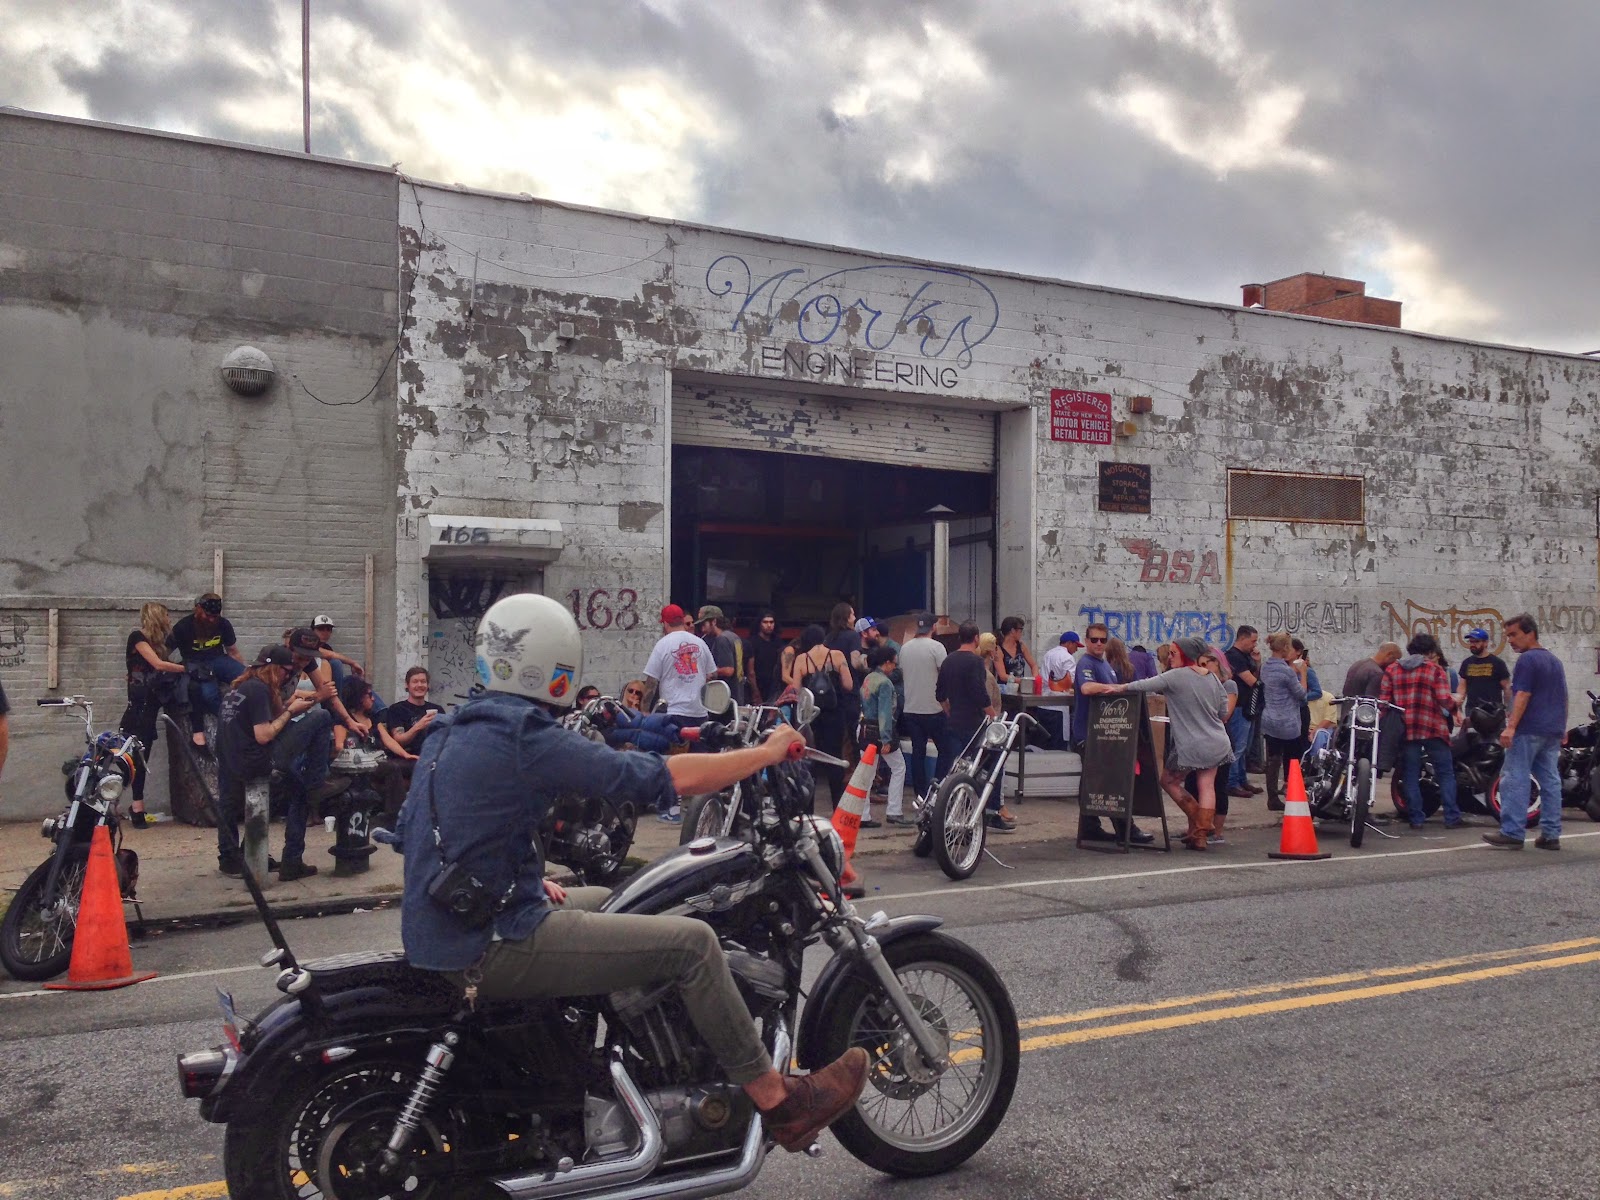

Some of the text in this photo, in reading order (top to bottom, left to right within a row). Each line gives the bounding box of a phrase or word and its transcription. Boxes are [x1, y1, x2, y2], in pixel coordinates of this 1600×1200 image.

[706, 256, 999, 370] Works
[761, 346, 958, 388] ENGINEERING
[1054, 392, 1108, 413] REGISTERED
[1053, 417, 1110, 431] MOTOR VEHICLE
[1055, 428, 1108, 442] RETAIL DEALER
[1104, 465, 1147, 480] MOTORCYCLE
[1112, 480, 1138, 488] STORAGE
[1139, 550, 1222, 584] BSA
[1078, 604, 1236, 652] TRIUMPH
[1266, 602, 1360, 634] DUCATI
[1381, 599, 1507, 656] Norton
[1538, 605, 1597, 634] MOTO
